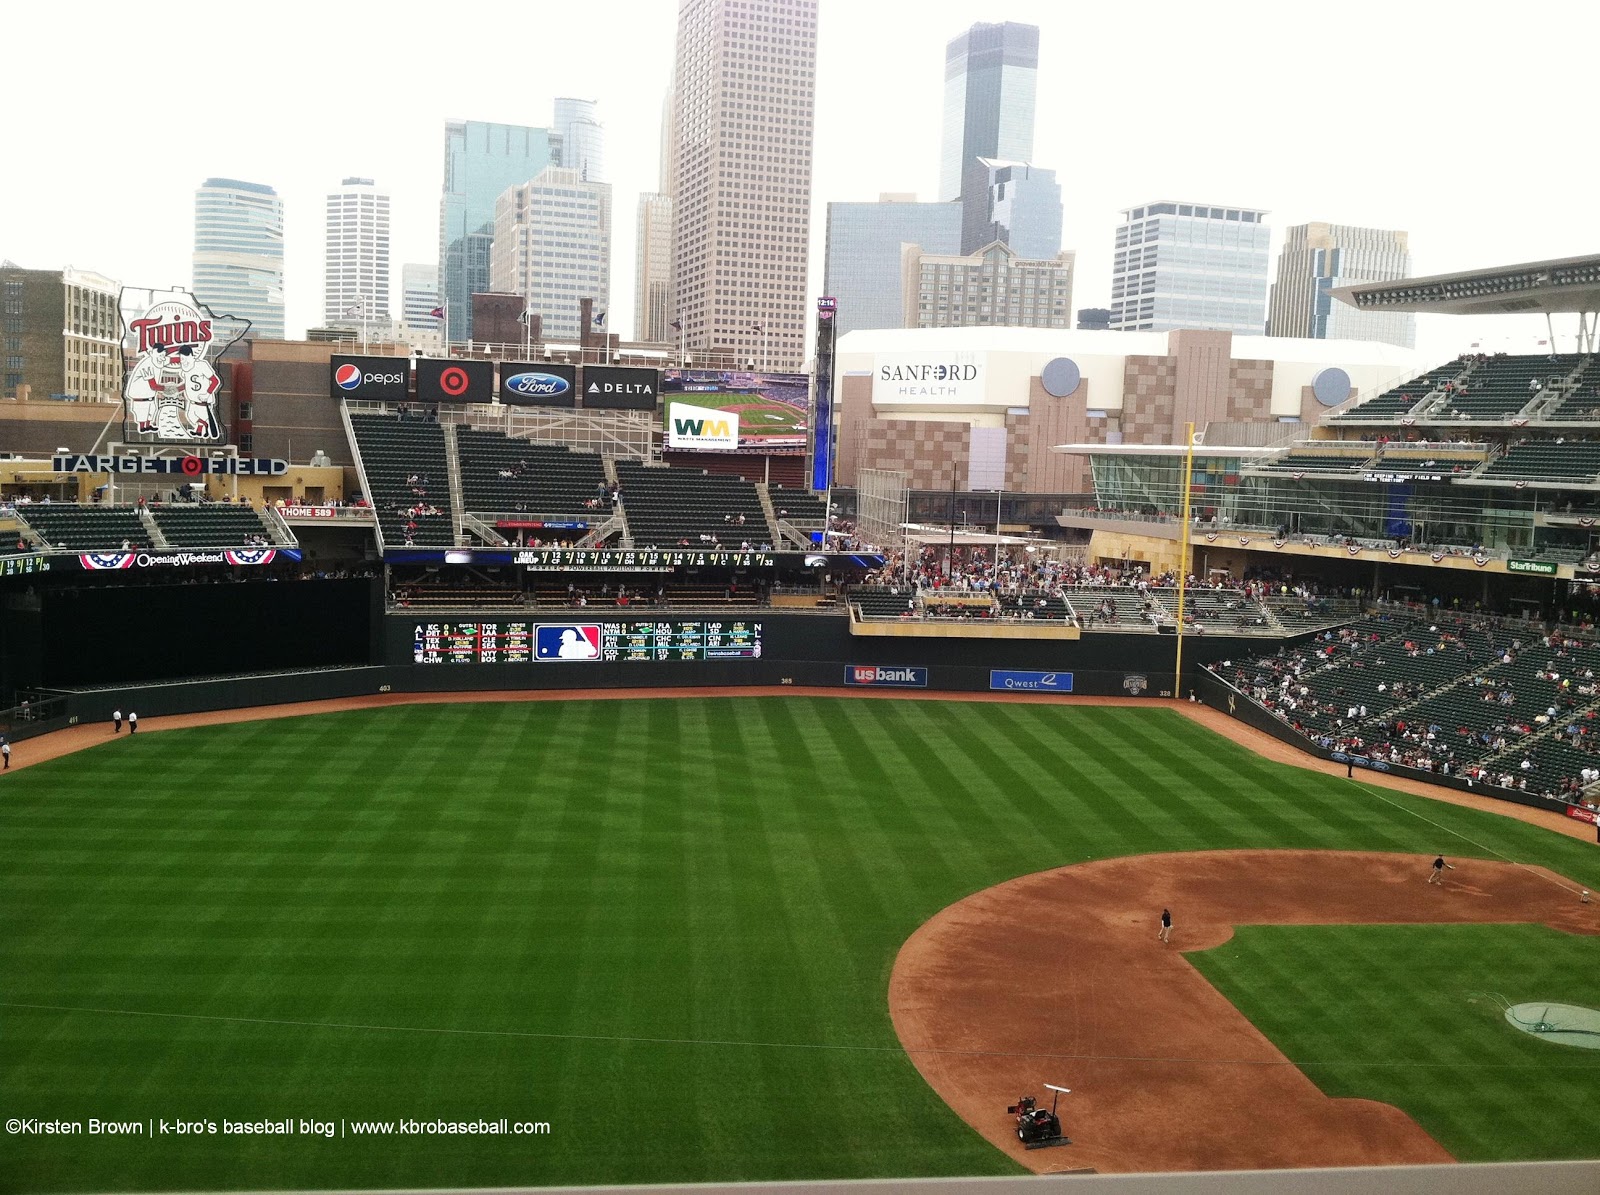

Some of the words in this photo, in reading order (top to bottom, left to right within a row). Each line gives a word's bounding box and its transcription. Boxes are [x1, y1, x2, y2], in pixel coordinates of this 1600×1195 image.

[130, 315, 212, 353] Twins
[364, 372, 404, 385] pepsi
[881, 364, 977, 381] SANFORD
[518, 376, 556, 393] Ford
[604, 382, 652, 394] DELTA
[899, 386, 956, 396] HEALTH
[674, 418, 730, 436] WM
[55, 455, 178, 474] TARGET
[208, 457, 289, 475] FIELD
[280, 508, 312, 516] THOME
[314, 509, 332, 517] 589
[1510, 562, 1552, 573] StarTribune
[415, 625, 423, 633] A
[1005, 678, 1039, 689] Qwest
